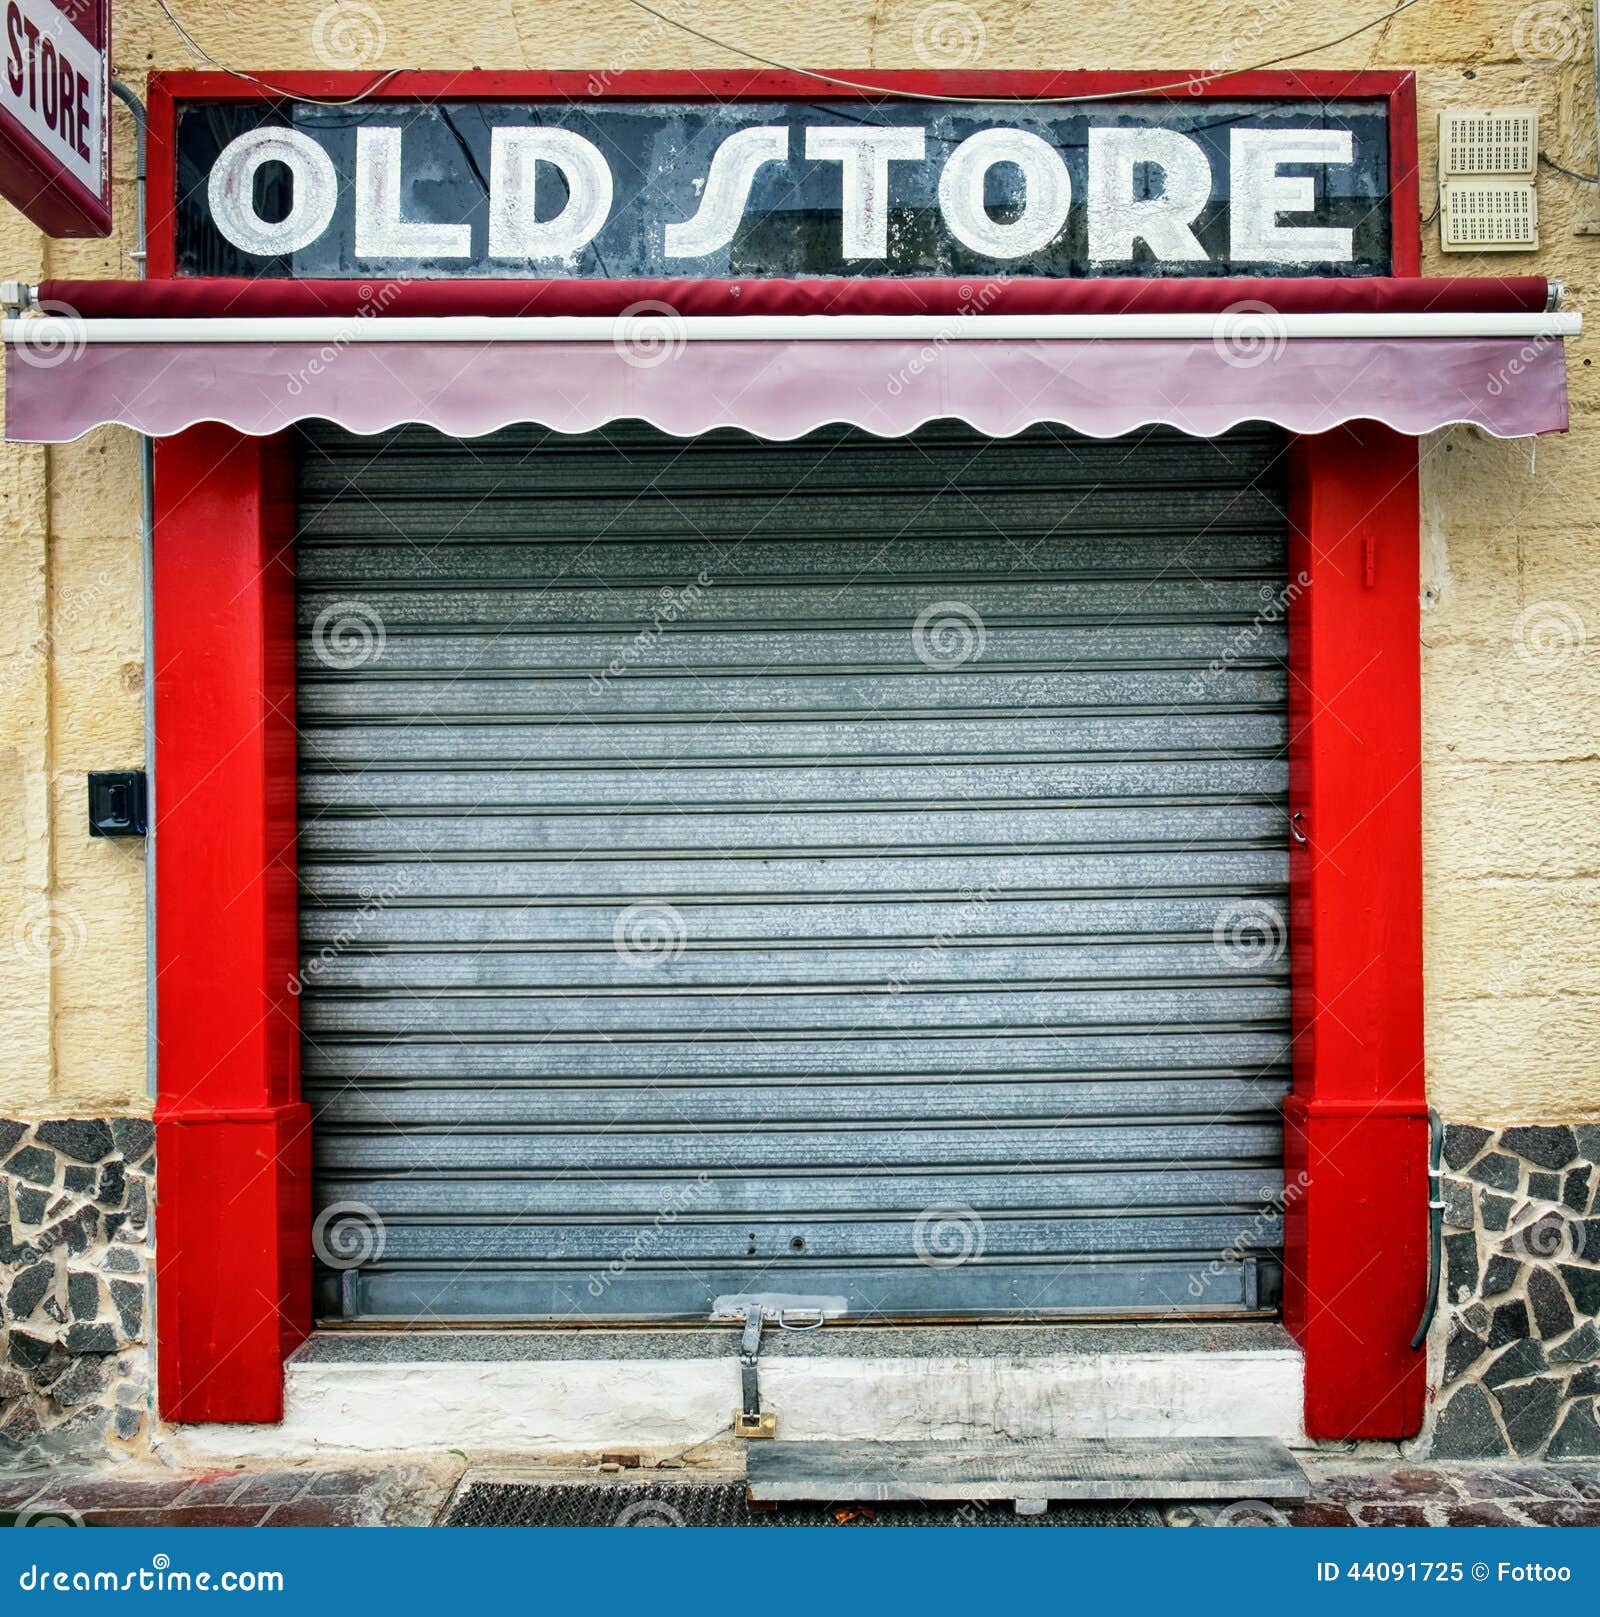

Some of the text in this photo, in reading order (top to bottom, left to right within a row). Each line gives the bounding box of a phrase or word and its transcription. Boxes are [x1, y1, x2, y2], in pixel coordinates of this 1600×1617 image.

[7, 0, 91, 164] STORE
[208, 125, 1354, 262] OLD STORE
